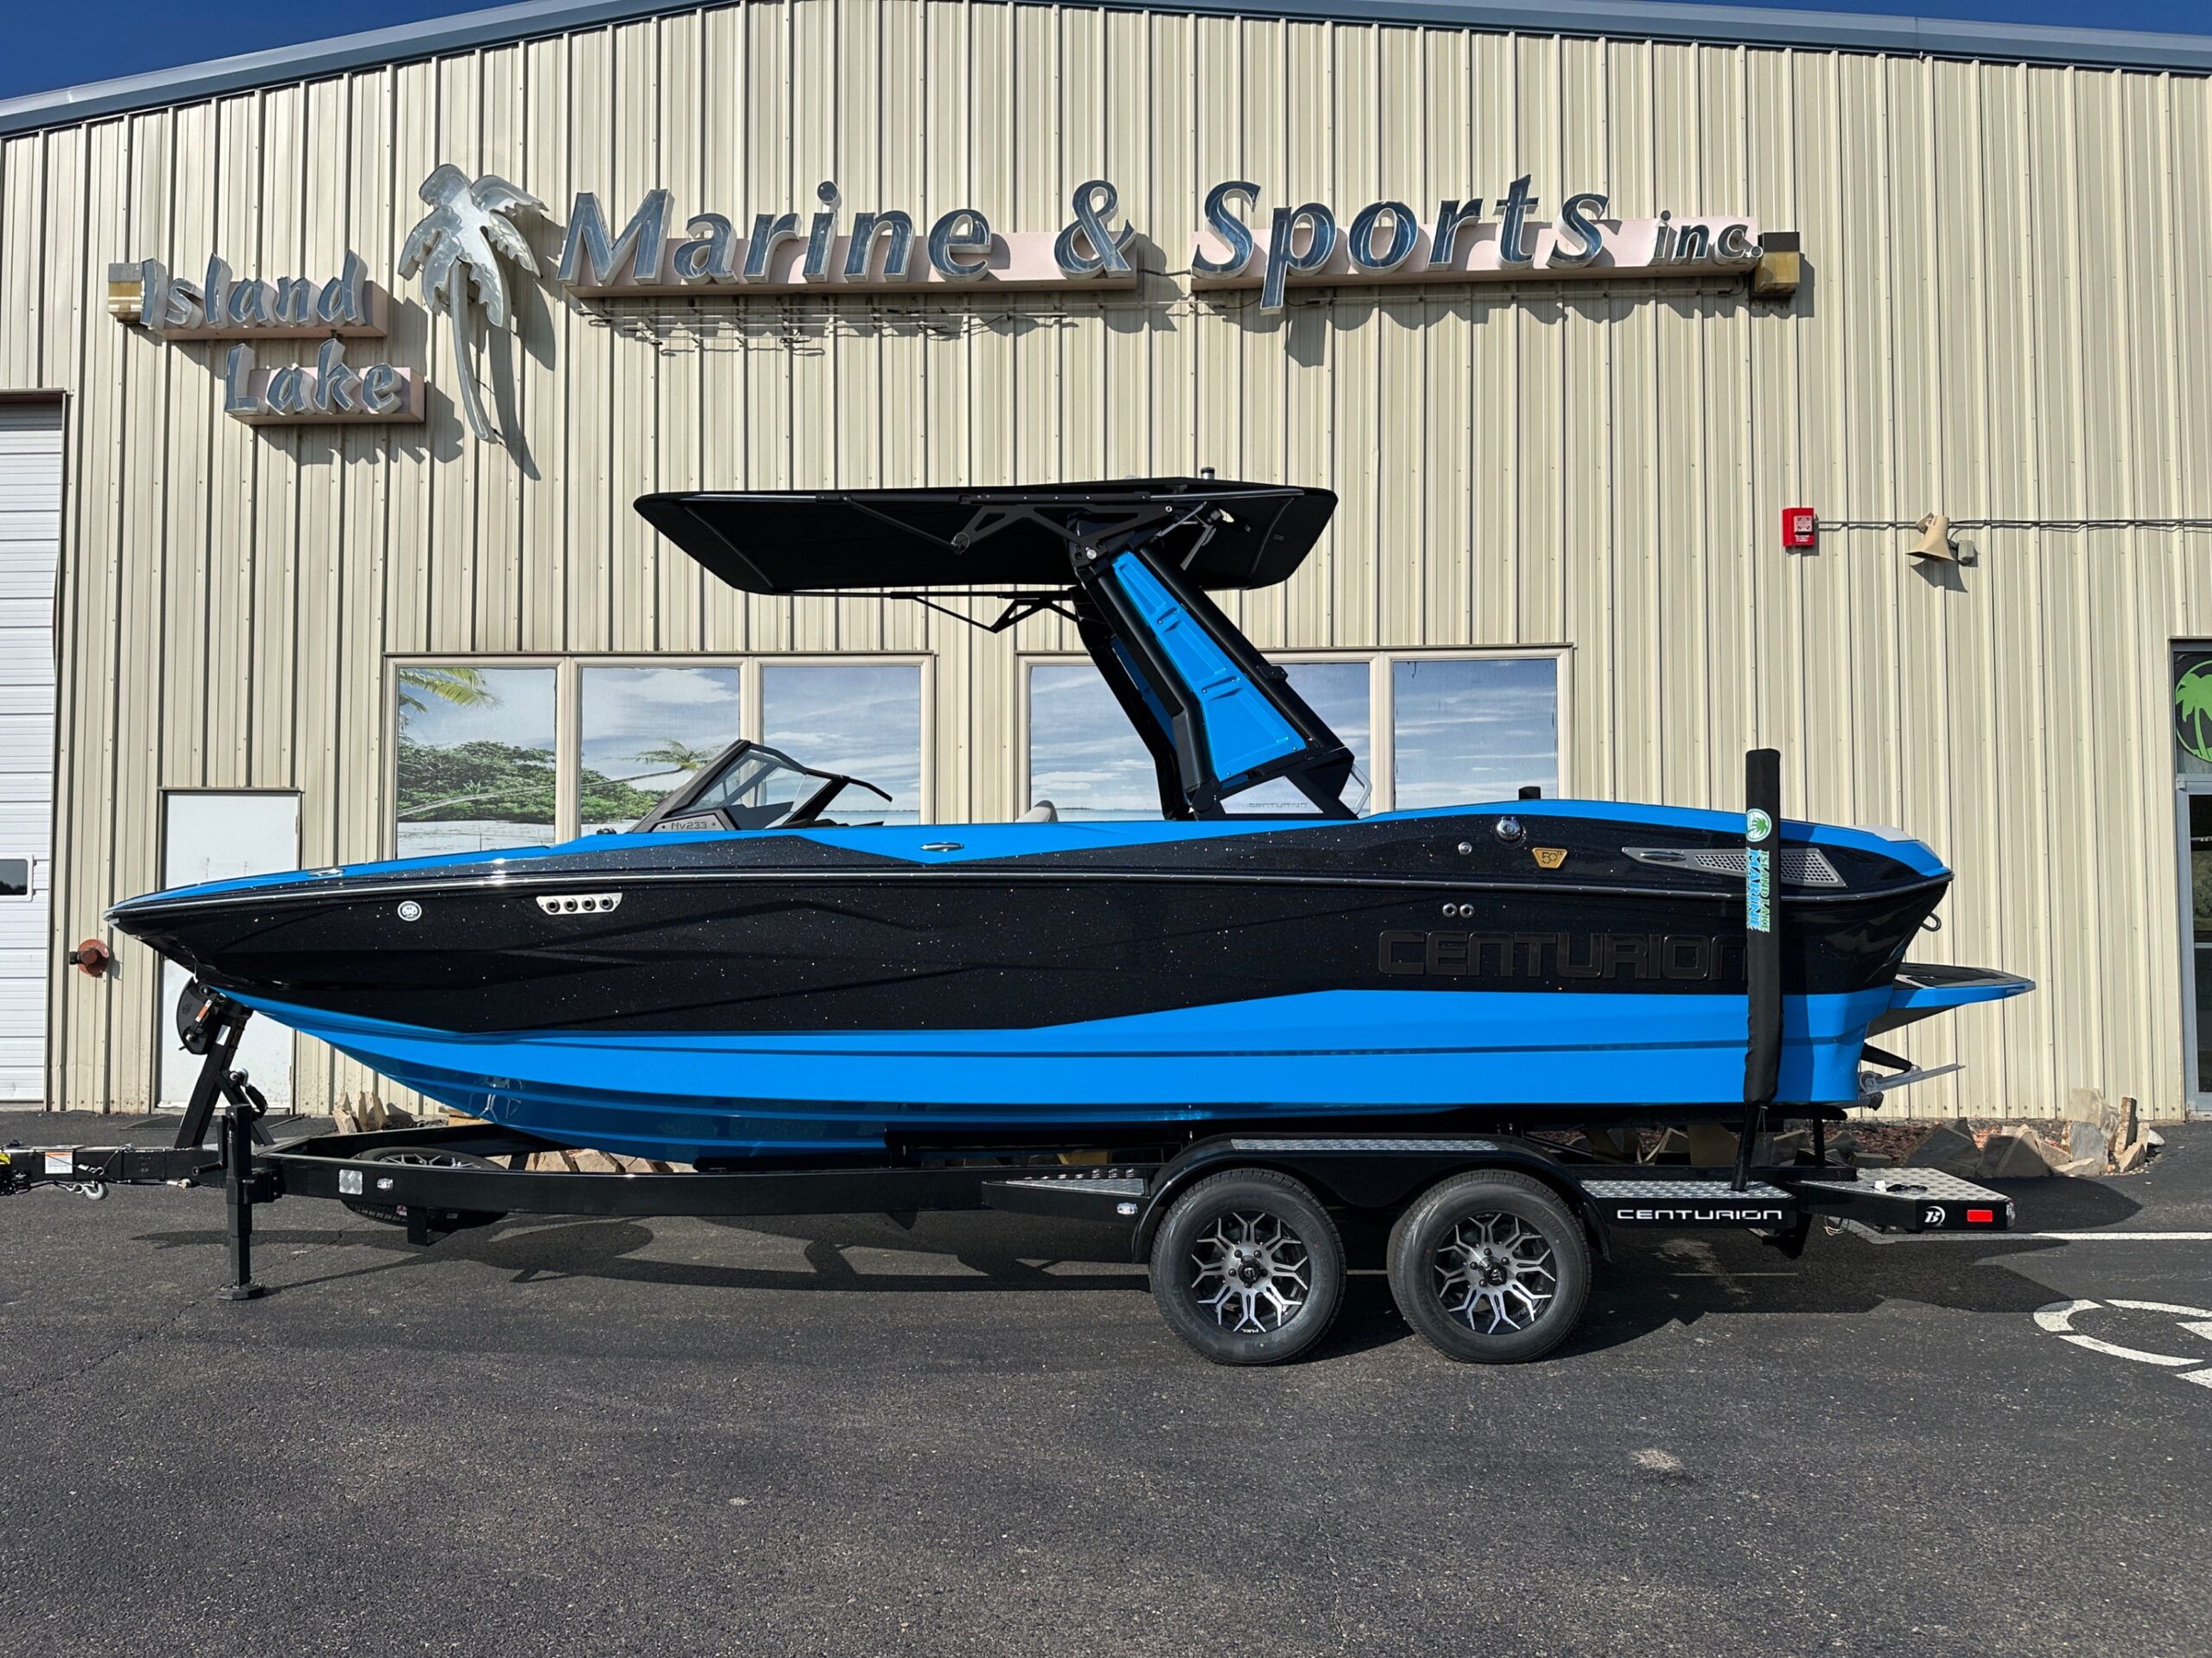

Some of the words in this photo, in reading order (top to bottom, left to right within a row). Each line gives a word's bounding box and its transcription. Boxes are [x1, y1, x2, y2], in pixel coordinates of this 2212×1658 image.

[556, 180, 992, 285] Marine
[1053, 179, 1137, 280] &
[1191, 174, 1609, 315] Sports
[1651, 209, 1764, 260] inc.
[140, 249, 367, 329] Island
[224, 338, 401, 415] Lake
[1748, 849, 1761, 928] MARINE
[1760, 850, 1770, 897] ISLAND
[1760, 899, 1770, 931] LAKE
[1617, 1209, 1783, 1220] CENTURION
